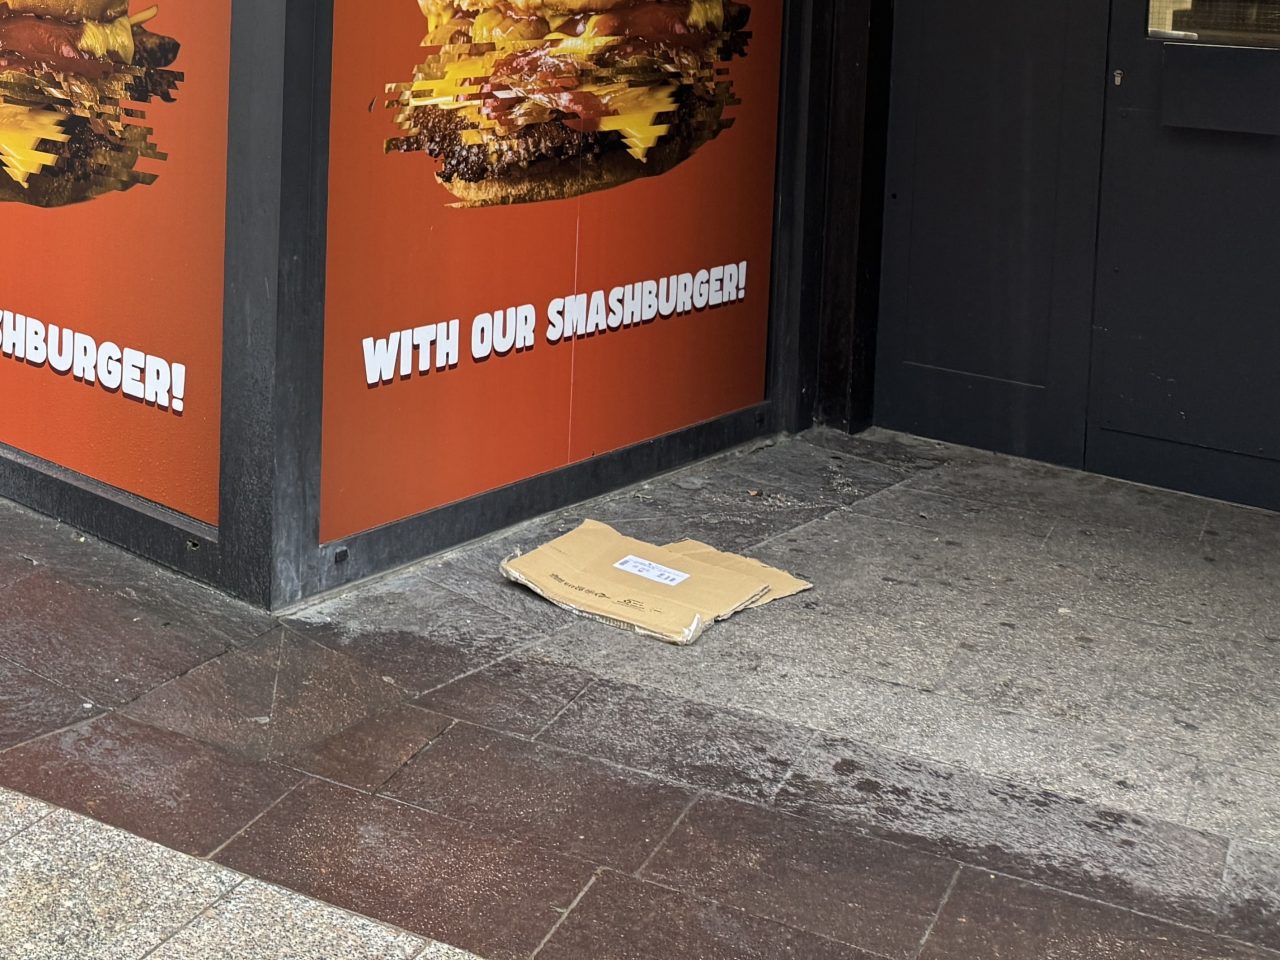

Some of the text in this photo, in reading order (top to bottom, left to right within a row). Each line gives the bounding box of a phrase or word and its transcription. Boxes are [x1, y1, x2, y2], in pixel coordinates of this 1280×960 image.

[361, 260, 748, 390] WITH OUR SMASHBURGER!
